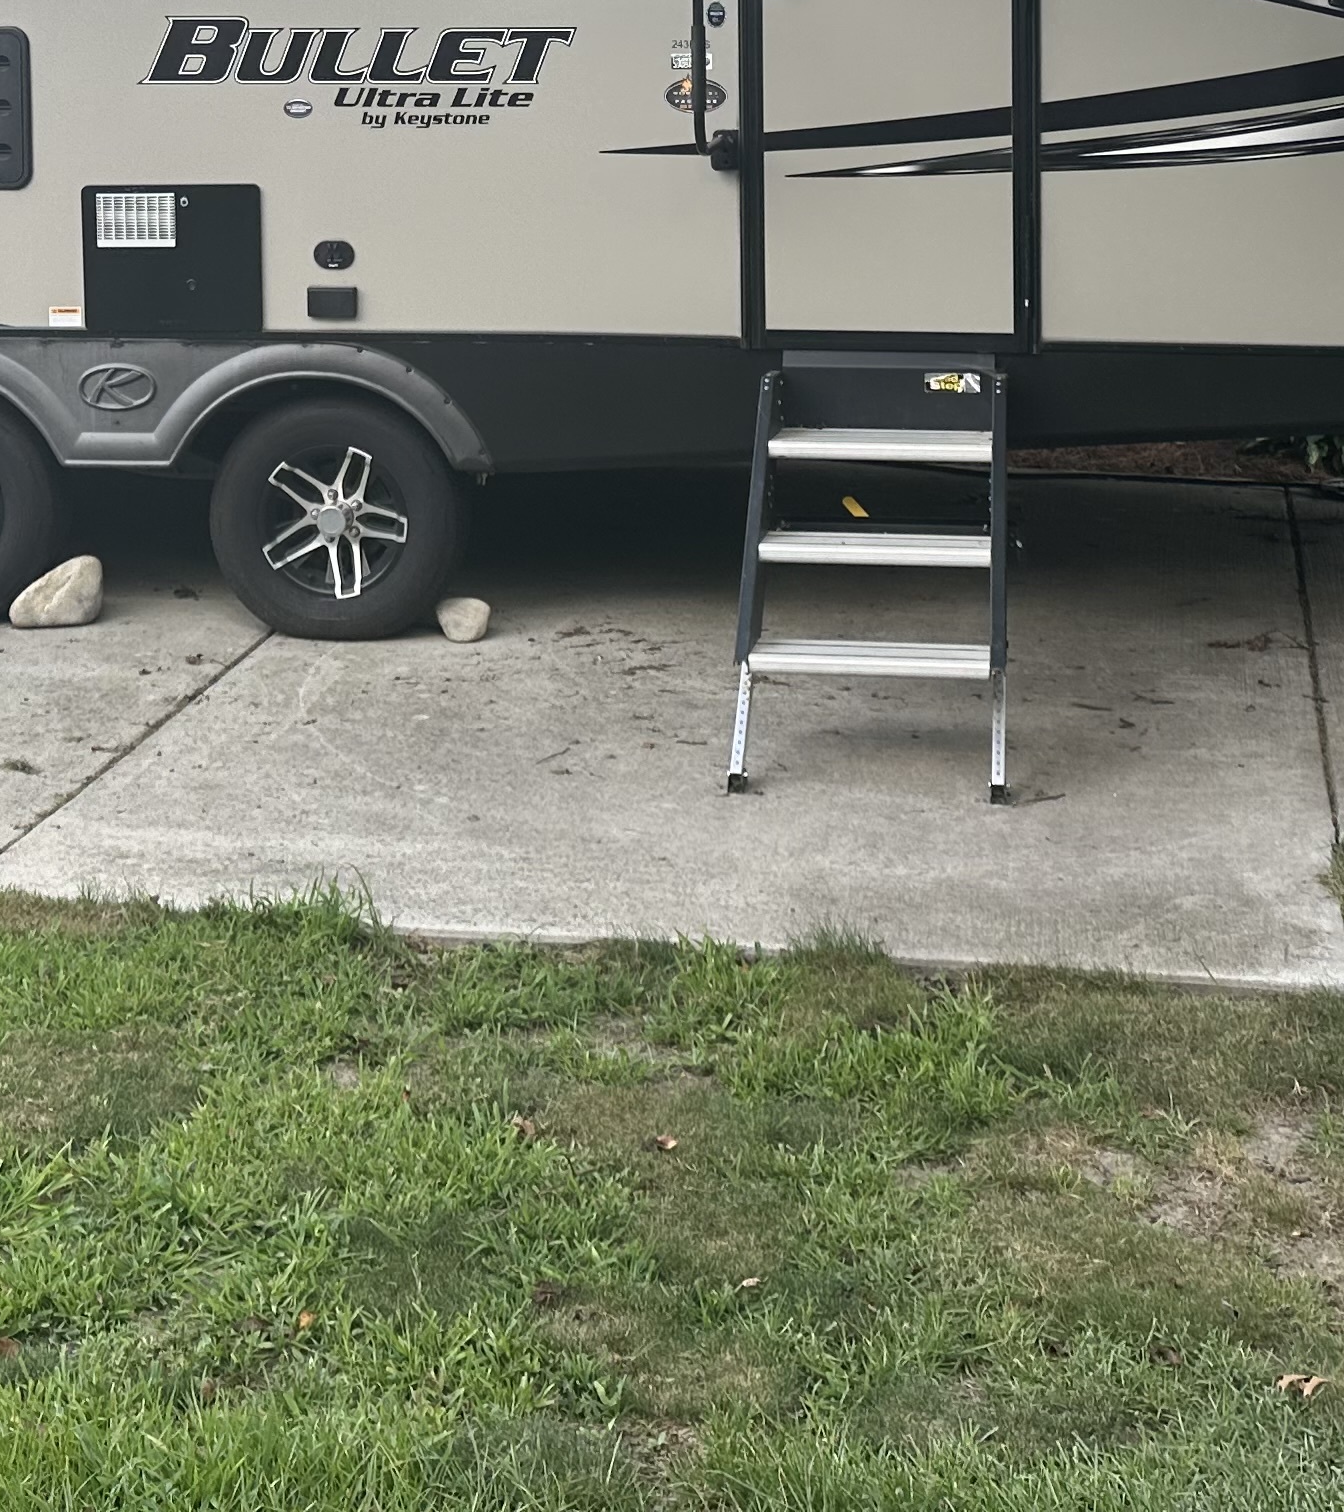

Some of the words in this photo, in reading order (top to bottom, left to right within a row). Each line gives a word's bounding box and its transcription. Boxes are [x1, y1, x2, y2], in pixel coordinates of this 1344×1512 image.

[137, 16, 577, 85] BULLET
[334, 87, 441, 108] Ultra
[451, 87, 534, 108] Lite
[361, 111, 387, 129] by
[394, 111, 490, 129] Keystone
